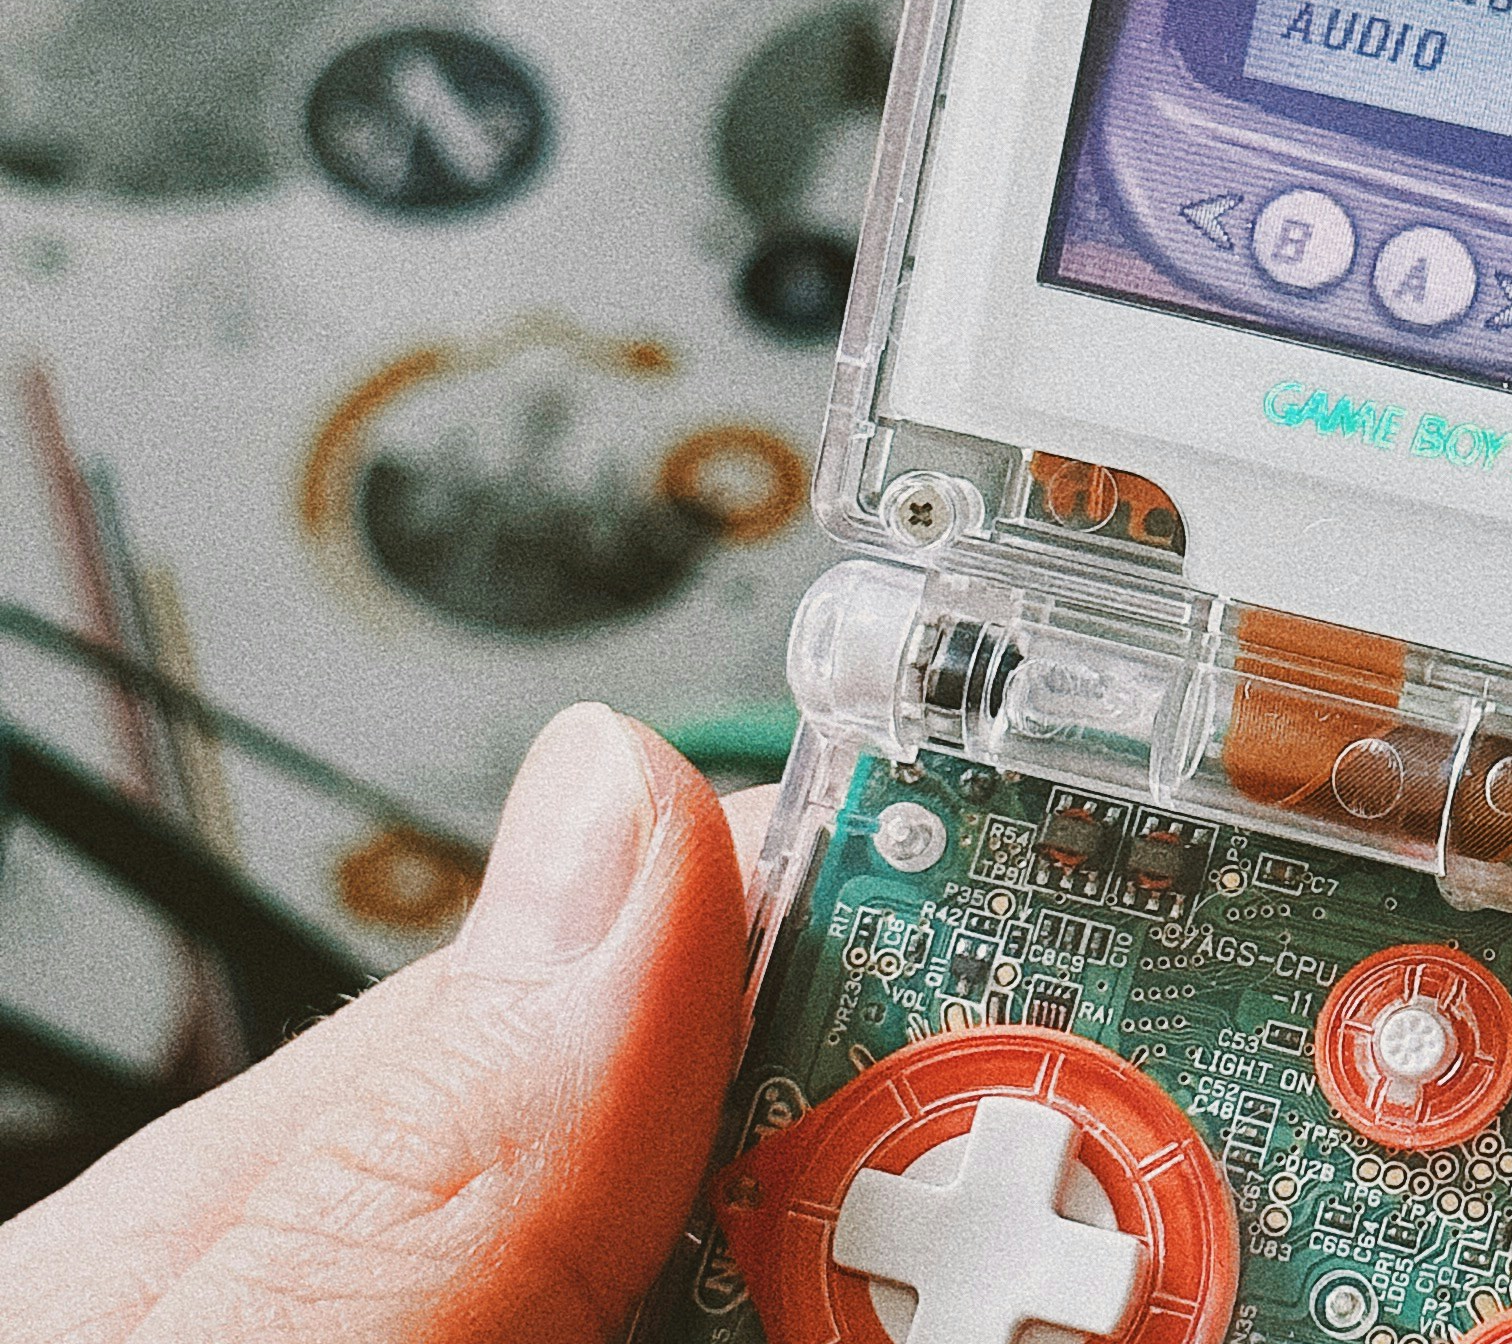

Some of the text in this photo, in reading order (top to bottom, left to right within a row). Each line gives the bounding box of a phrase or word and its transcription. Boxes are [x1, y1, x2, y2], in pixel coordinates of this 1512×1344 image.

[1280, 1, 1448, 72] AUDIO
[1274, 218, 1316, 263] B
[1396, 256, 1431, 305] A
[1263, 380, 1407, 451] GAME
[988, 821, 1029, 847] R54
[943, 881, 985, 906] P35
[1310, 875, 1340, 897] C7
[828, 902, 854, 939] R17
[920, 900, 963, 927] R42
[1028, 944, 1056, 967] C8
[1053, 950, 1086, 973] C9
[1108, 931, 1134, 968] C10
[1217, 1027, 1261, 1054] C53
[1193, 1046, 1318, 1097] LIGHT ON
[1198, 1075, 1241, 1100] C52
[1190, 1094, 1235, 1121] C48
[1342, 1181, 1384, 1207] TP6
[1249, 1239, 1293, 1263] U83
[1308, 1231, 1352, 1258] C65
[1353, 1220, 1380, 1263] C64
[1436, 1266, 1479, 1292] CL2
